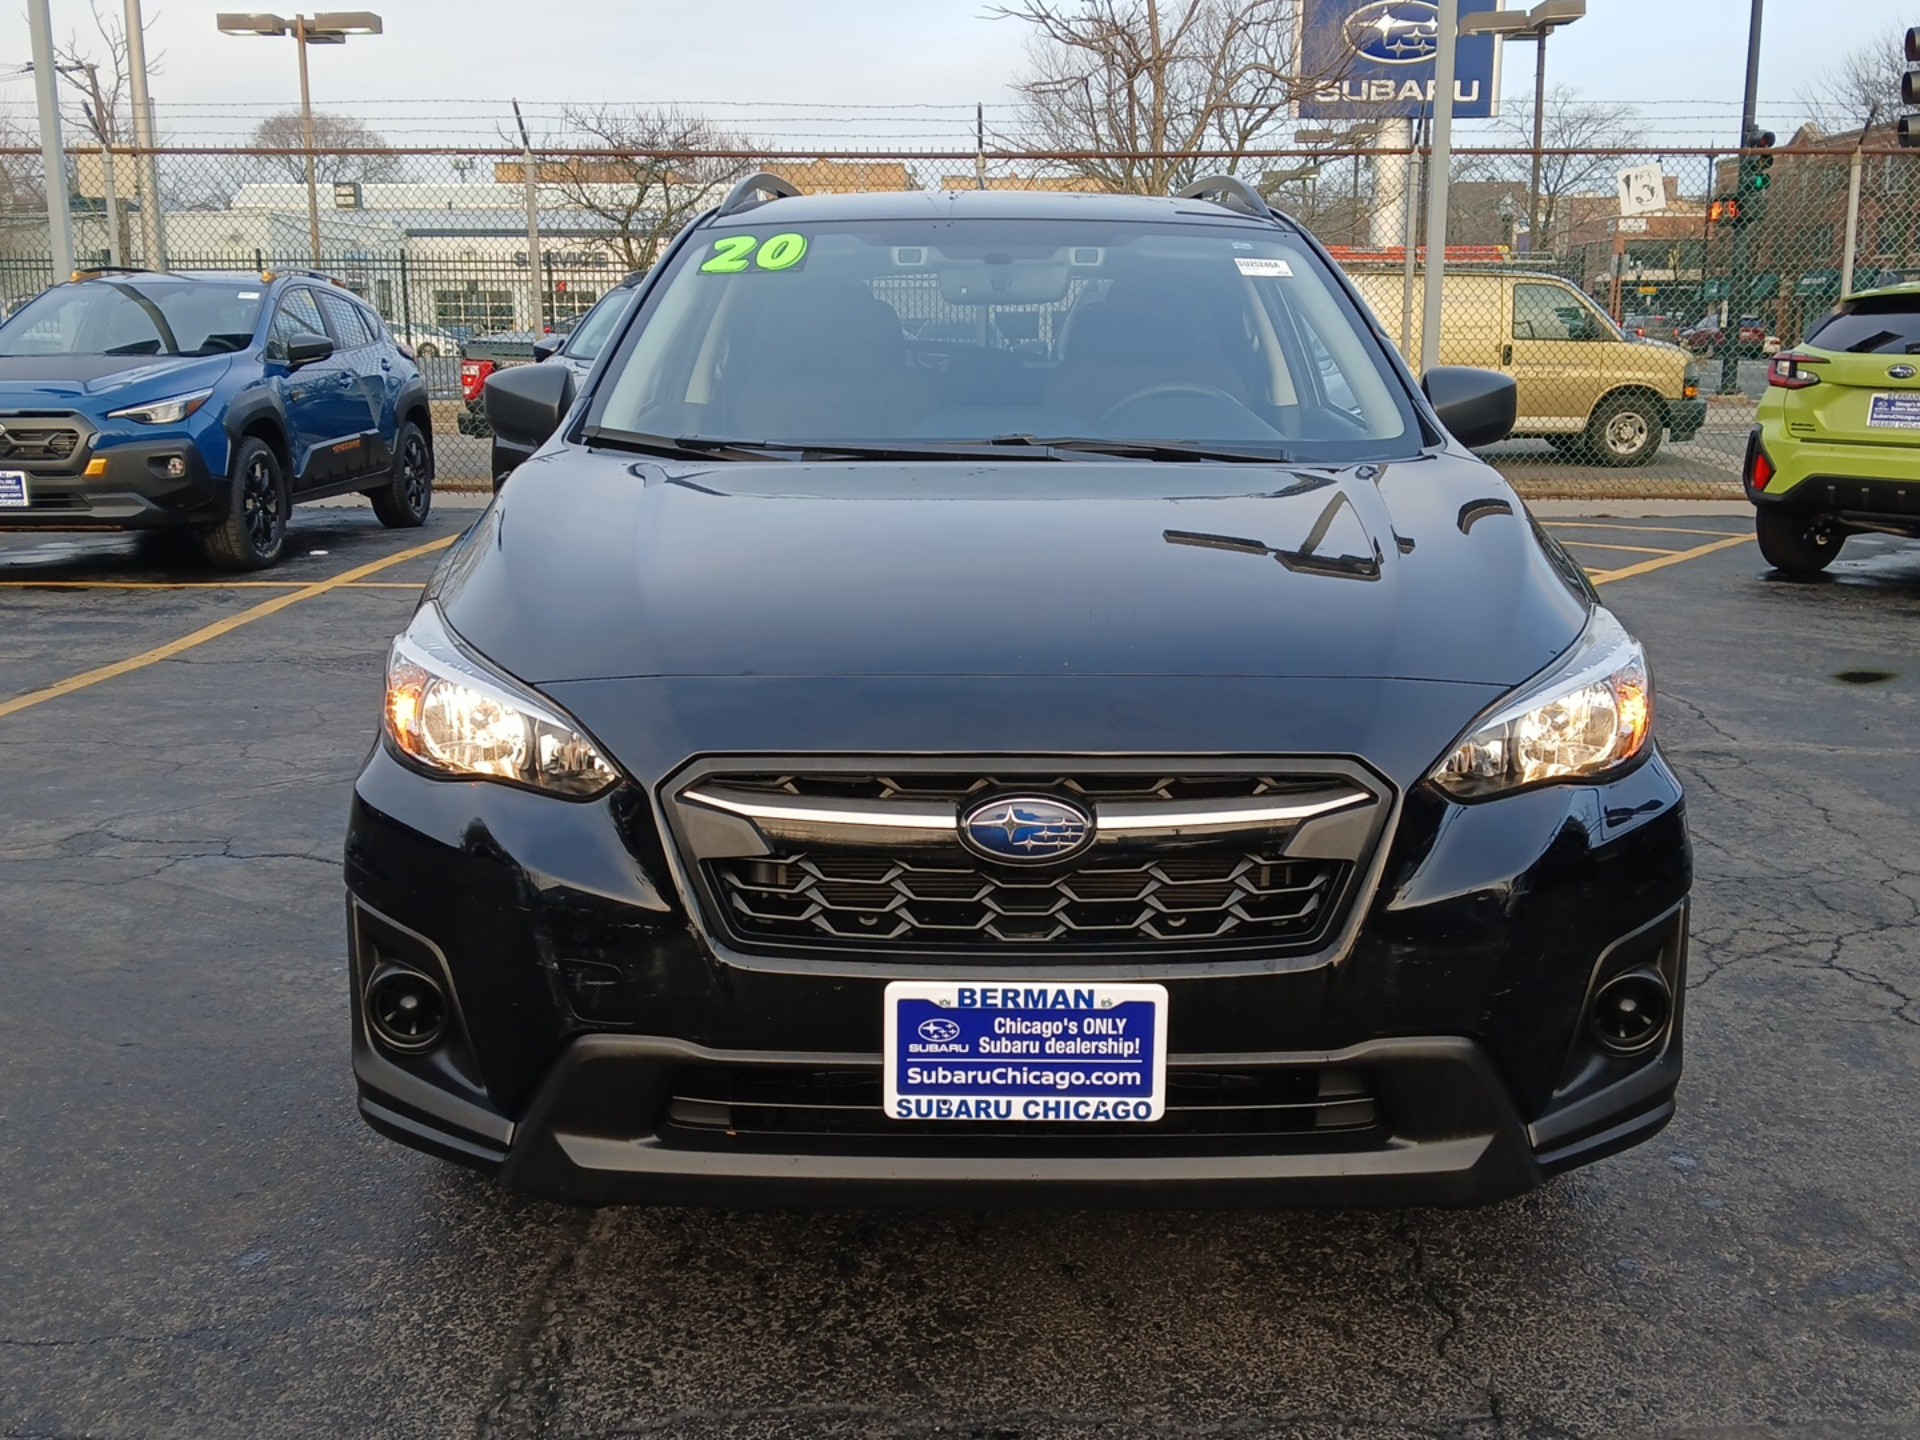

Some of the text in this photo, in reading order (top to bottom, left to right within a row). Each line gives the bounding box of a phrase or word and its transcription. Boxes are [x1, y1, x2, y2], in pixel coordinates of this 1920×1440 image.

[701, 232, 808, 273] 20
[957, 988, 1095, 1009] BERMAN
[994, 1017, 1127, 1037] Chicago's ONLY
[908, 1043, 969, 1053] SUBARU
[978, 1037, 1140, 1057] Subaru dealership!
[907, 1067, 1141, 1089] SubaruChicago.com
[896, 1098, 1152, 1120] SUBARU CHICAGO
